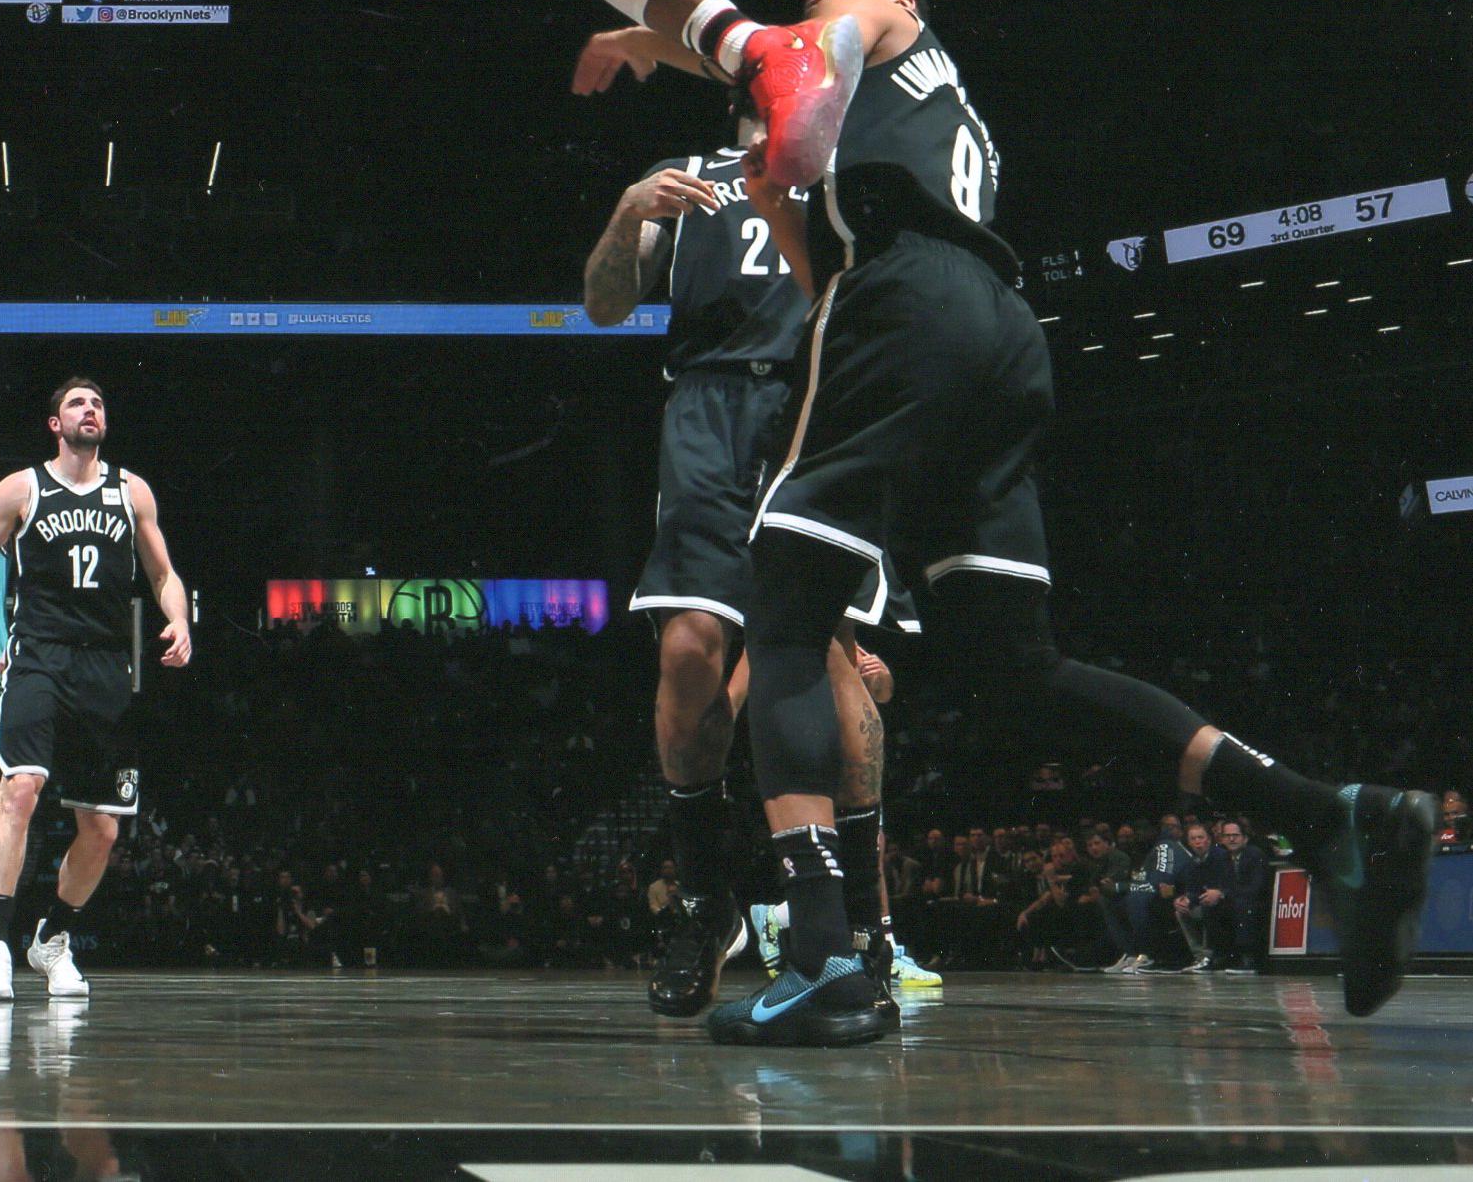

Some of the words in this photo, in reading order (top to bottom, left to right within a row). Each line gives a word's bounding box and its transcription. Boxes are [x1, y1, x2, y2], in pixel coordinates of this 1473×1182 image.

[116, 9, 212, 22] @BrooklynNets
[951, 124, 983, 223] 8
[1278, 204, 1323, 227] 4:08
[1356, 193, 1394, 222] 57
[1207, 222, 1245, 249] 69
[1270, 232, 1289, 244] 3rd
[1292, 224, 1335, 240] Quarter
[36, 509, 127, 543] BROOKLYN
[68, 545, 99, 589] 12
[1278, 895, 1304, 919] infor
